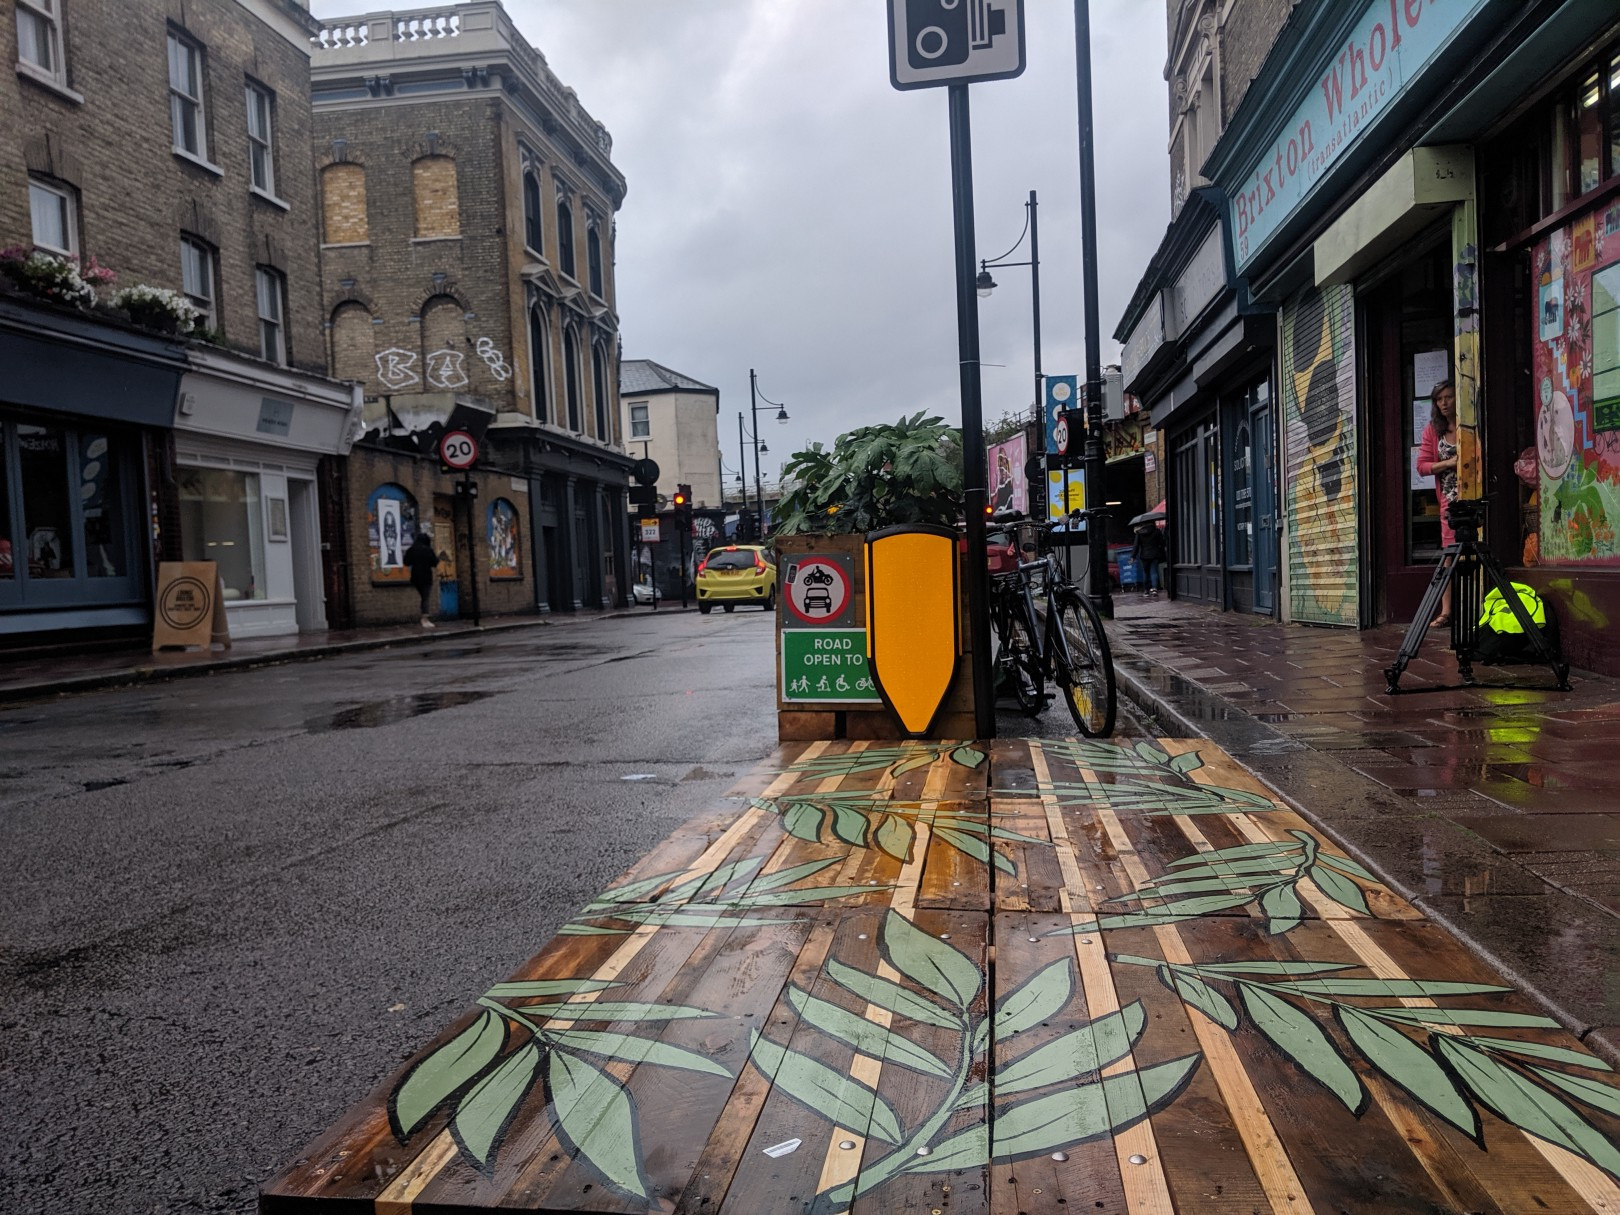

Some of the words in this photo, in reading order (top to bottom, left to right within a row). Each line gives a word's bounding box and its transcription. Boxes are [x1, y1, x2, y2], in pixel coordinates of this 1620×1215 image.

[1235, 119, 1315, 239] Brixton
[1321, 0, 1437, 125] Whole
[1307, 66, 1394, 181] (transatlantic)
[1240, 236, 1249, 261] 59
[1057, 428, 1067, 445] 20
[445, 440, 472, 459] 20
[814, 638, 852, 650] ROAD
[803, 654, 841, 666] OPEN
[845, 654, 863, 666] TO
